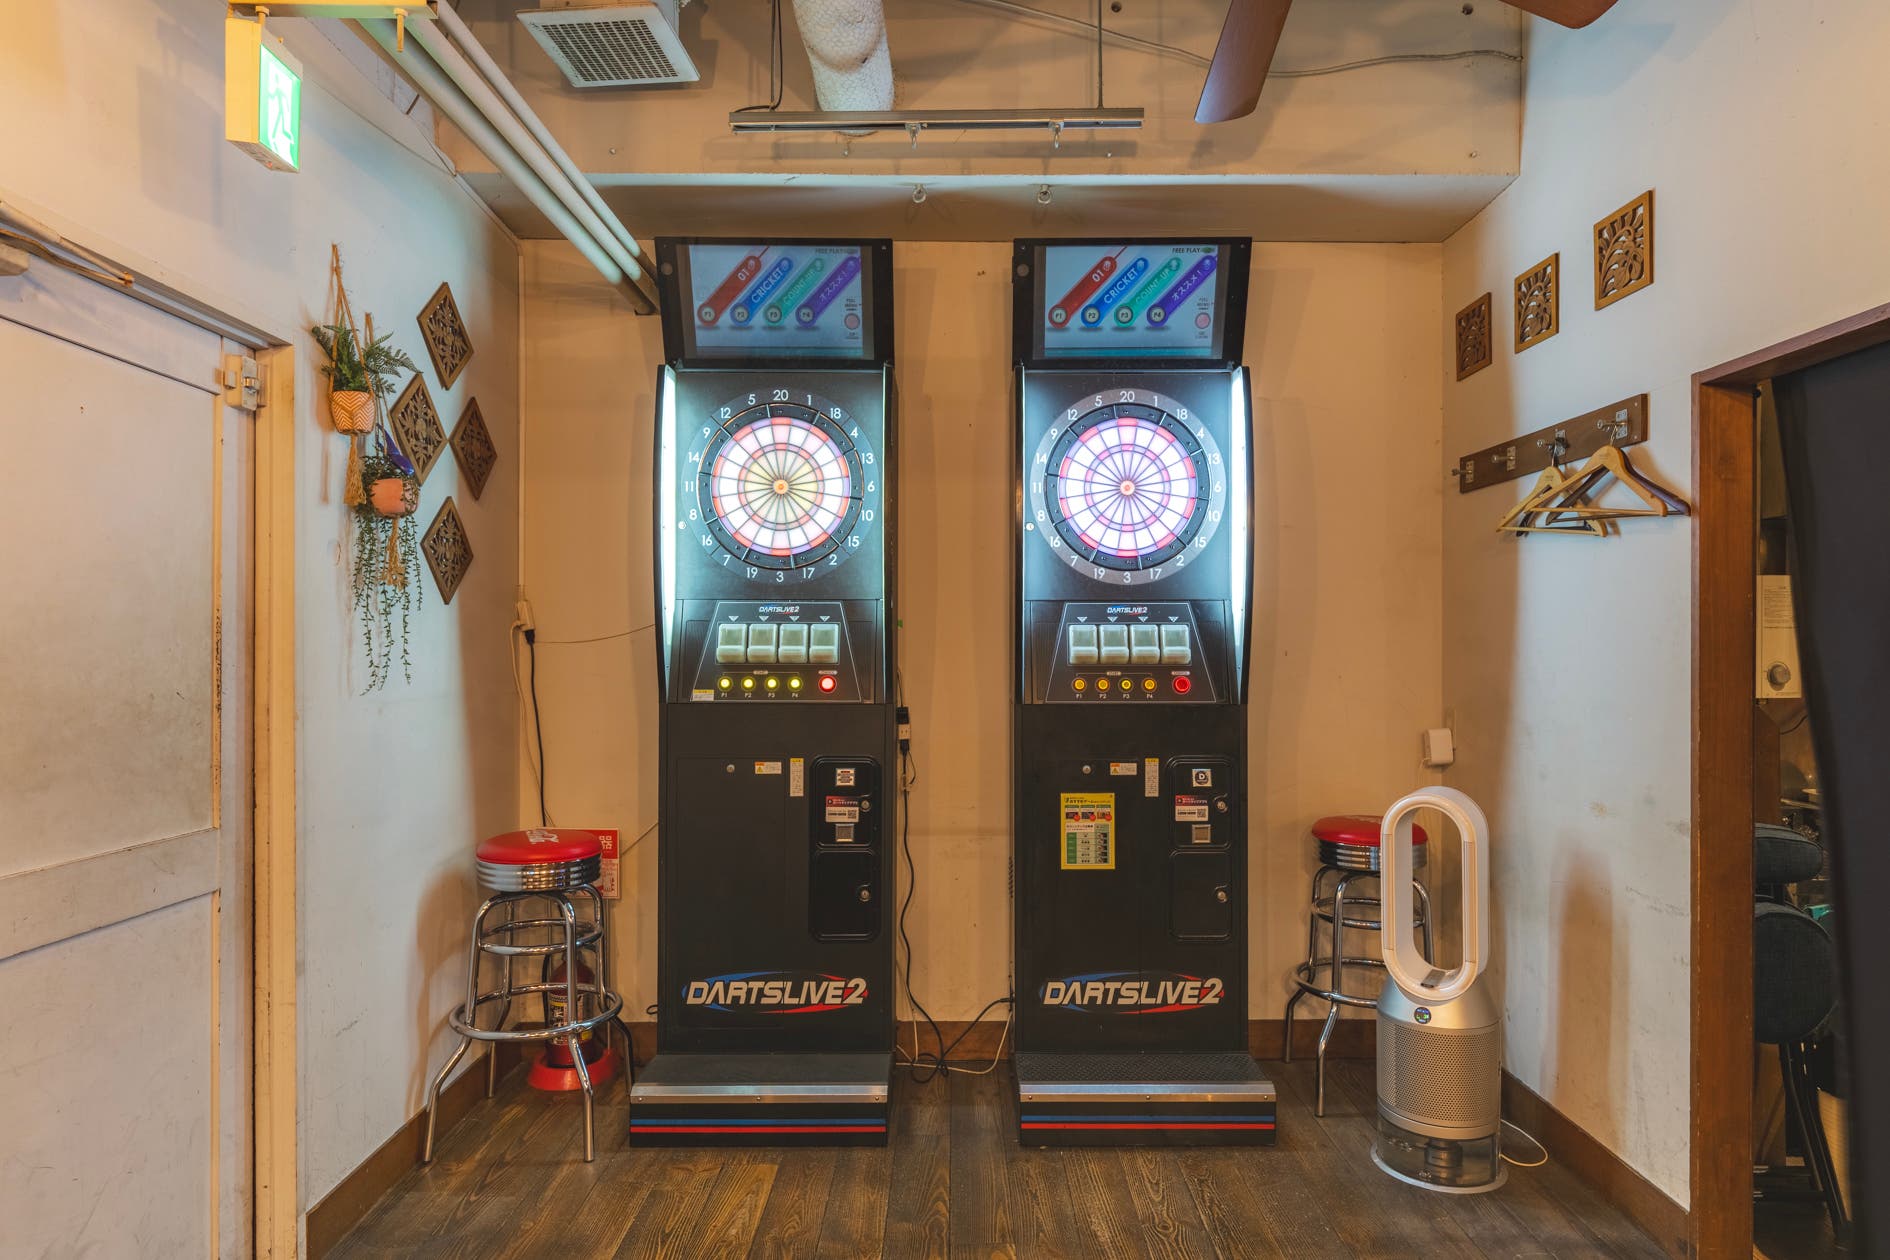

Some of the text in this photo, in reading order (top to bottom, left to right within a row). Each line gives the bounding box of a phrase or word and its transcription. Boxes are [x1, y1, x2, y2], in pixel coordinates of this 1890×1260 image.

[738, 268, 749, 281] 01
[1092, 270, 1103, 282] 01
[751, 268, 782, 303] CRICKET
[1104, 268, 1138, 304] CRICKET
[748, 394, 755, 404] 5
[773, 390, 788, 401] 20
[807, 395, 811, 405] 1
[1120, 391, 1134, 402] 20
[1095, 396, 1102, 406] 5
[1154, 397, 1157, 406] 1
[721, 408, 731, 418] 12
[830, 408, 841, 418] 18
[1068, 410, 1078, 420] 12
[1177, 409, 1187, 419] 18
[703, 428, 710, 438] 9
[850, 428, 858, 438] 4
[1051, 429, 1058, 439] 9
[1197, 428, 1204, 438] 4
[688, 453, 699, 462] 14
[862, 453, 873, 464] 13
[1036, 453, 1047, 463] 14
[1209, 454, 1220, 464] 13
[685, 482, 693, 492] 11
[868, 482, 874, 492] 6
[1033, 482, 1041, 492] 11
[1214, 482, 1221, 492] 6
[689, 510, 697, 520] 8
[862, 511, 873, 521] 10
[1038, 511, 1045, 521] 8
[1208, 511, 1220, 521] 10
[702, 535, 712, 545] 16
[848, 536, 859, 547] 15
[1051, 537, 1060, 547] 16
[1195, 537, 1206, 548] 15
[723, 555, 730, 565] 7
[830, 555, 837, 565] 2
[1071, 556, 1078, 566] 7
[1177, 556, 1184, 566] 2
[747, 568, 758, 578] 19
[776, 572, 783, 582] 3
[803, 568, 815, 578] 17
[1094, 569, 1105, 579] 19
[1124, 572, 1131, 583] 3
[1151, 569, 1161, 579] 17
[687, 978, 867, 1004] DARTSLIVE2
[1043, 978, 1223, 1004] DARTSLIVE2
